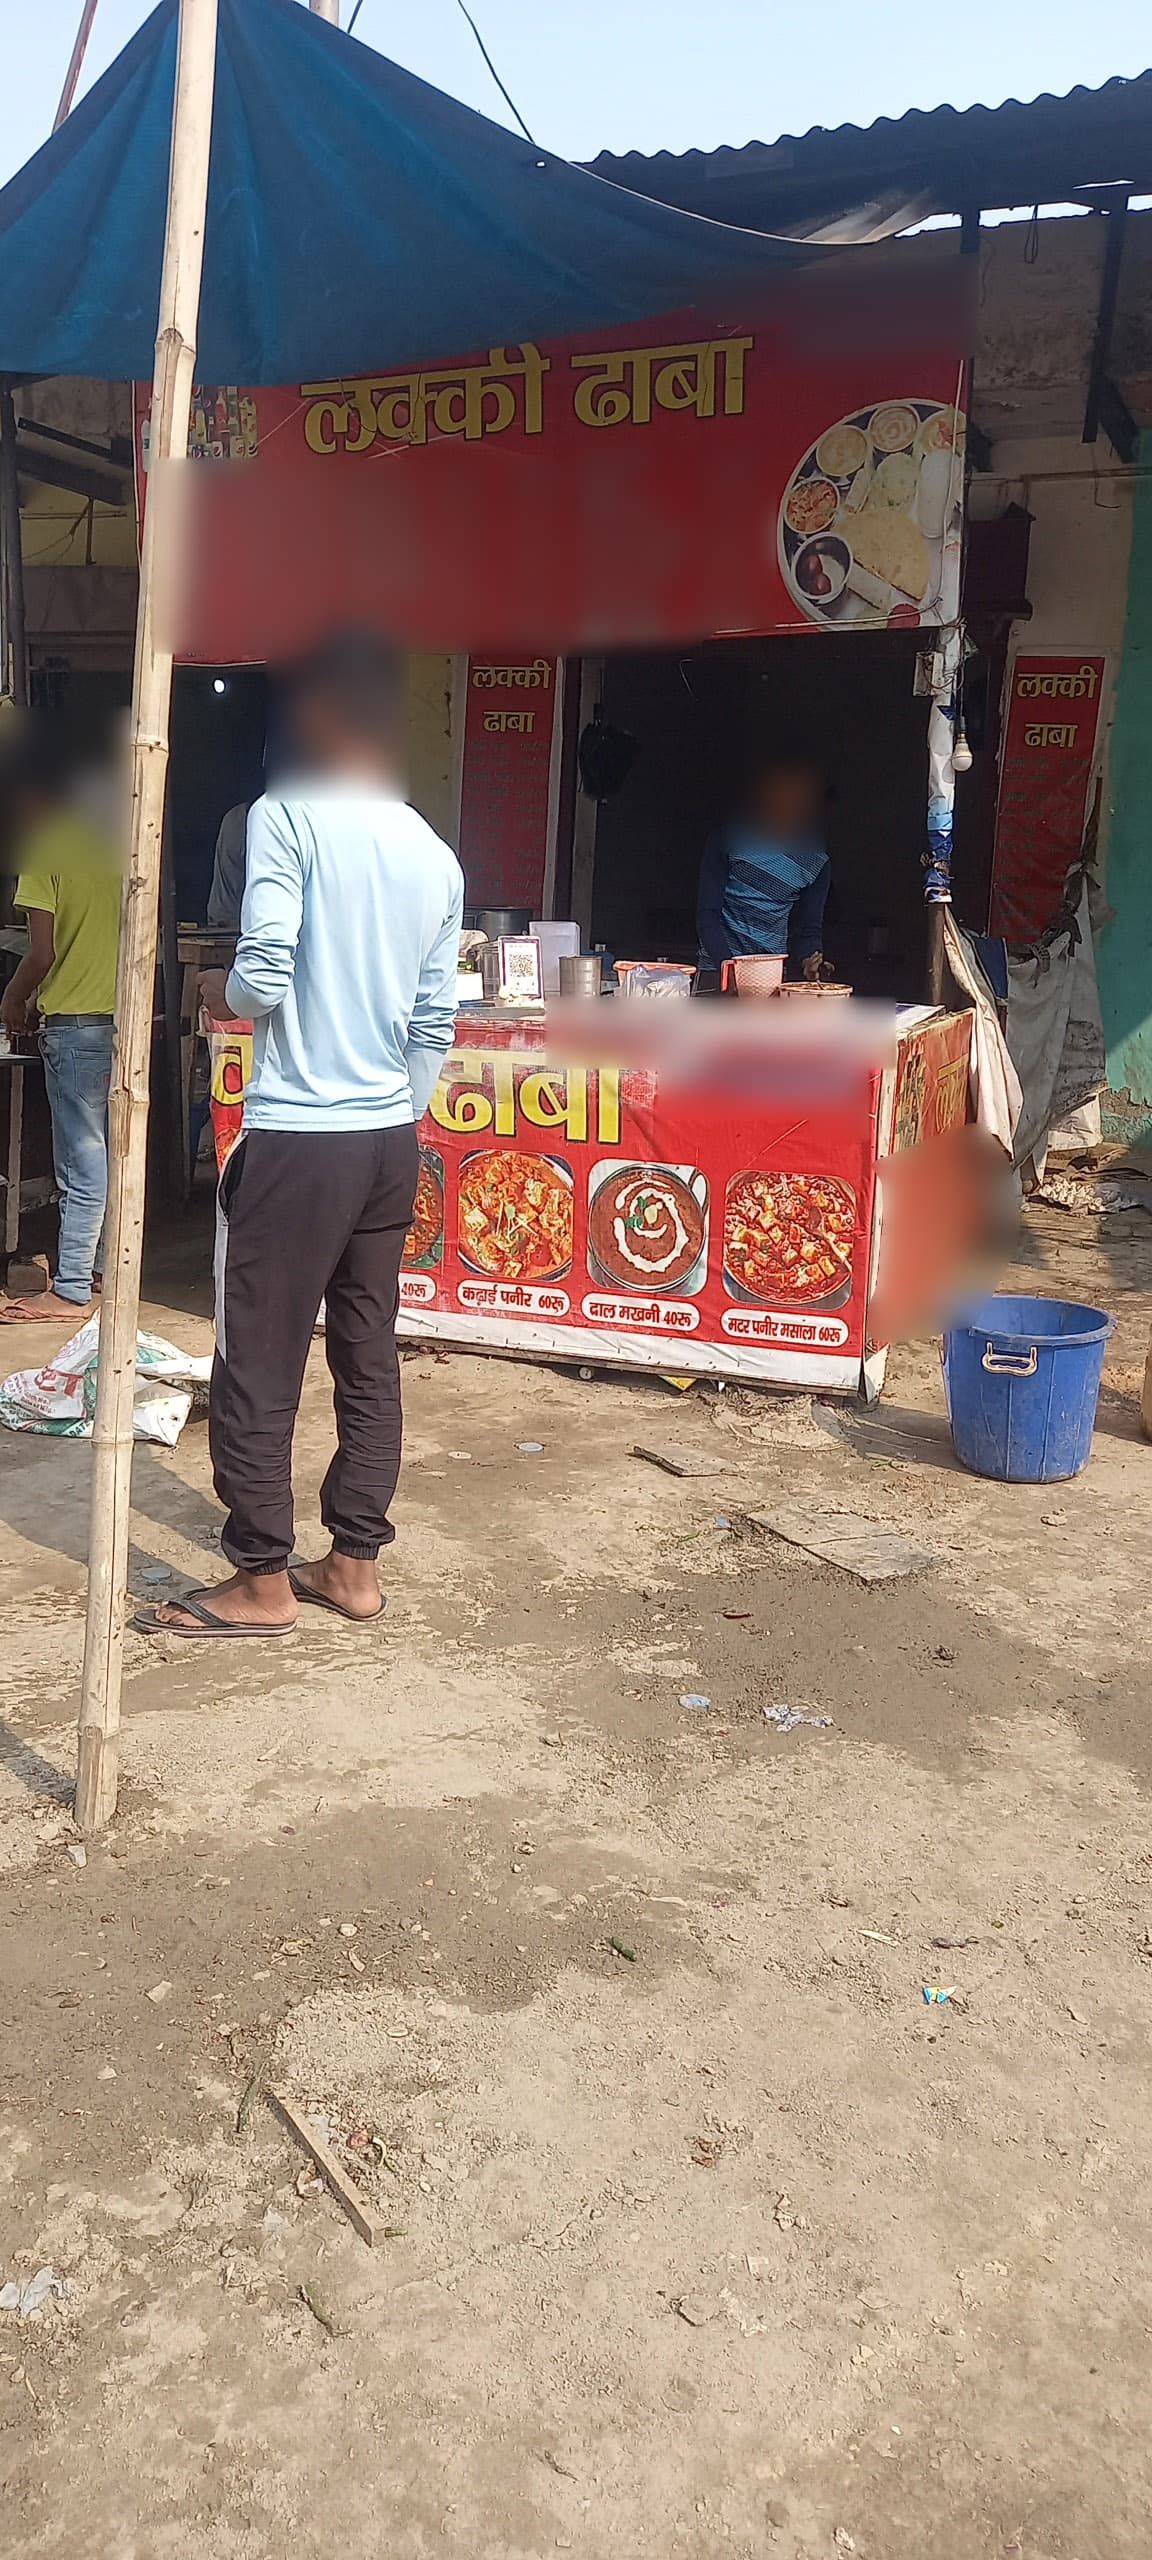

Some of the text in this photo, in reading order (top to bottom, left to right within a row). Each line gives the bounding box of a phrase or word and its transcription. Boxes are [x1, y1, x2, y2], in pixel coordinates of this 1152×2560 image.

[301, 337, 753, 454] लक्की ढाबा
[472, 659, 551, 689] लक्की
[1017, 665, 1098, 699] लक्की
[483, 711, 535, 733] ढाबा
[1024, 723, 1078, 748] ढाबा
[430, 1047, 620, 1144] ढाबा
[501, 1287, 532, 1307] पनीर
[589, 1302, 617, 1318] दाल
[619, 1303, 661, 1323] मखनी
[728, 1317, 750, 1333] मटर
[752, 1315, 779, 1336] पनीर
[780, 1323, 816, 1340] मसाला
